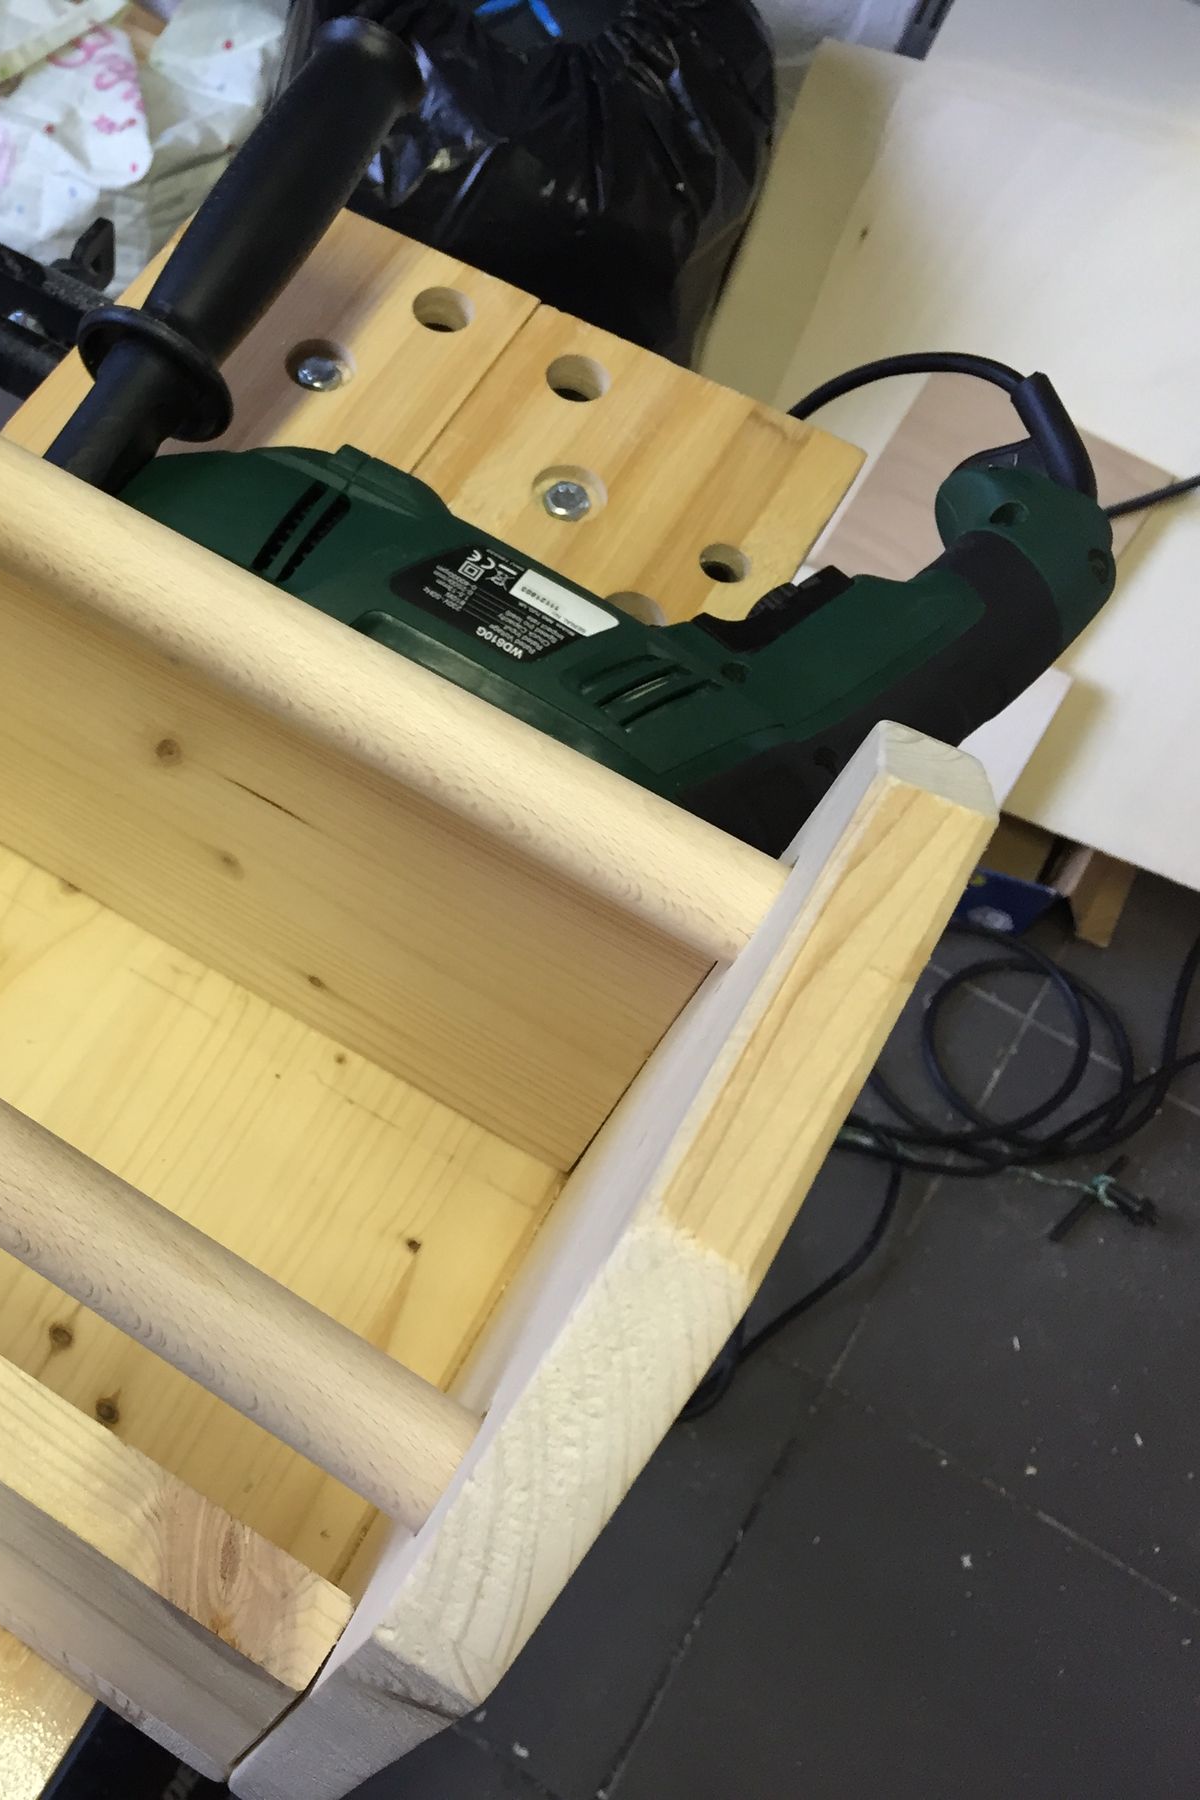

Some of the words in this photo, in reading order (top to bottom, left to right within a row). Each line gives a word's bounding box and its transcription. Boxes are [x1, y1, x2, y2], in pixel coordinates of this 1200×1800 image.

[498, 613, 528, 633] Capacity
[488, 624, 515, 642] Voltage
[503, 625, 522, 638] Input
[528, 631, 551, 647] Chuck
[534, 627, 558, 643] Speed
[475, 626, 523, 659] WD810G
[514, 639, 536, 655] Rated
[521, 635, 544, 651] Rated
